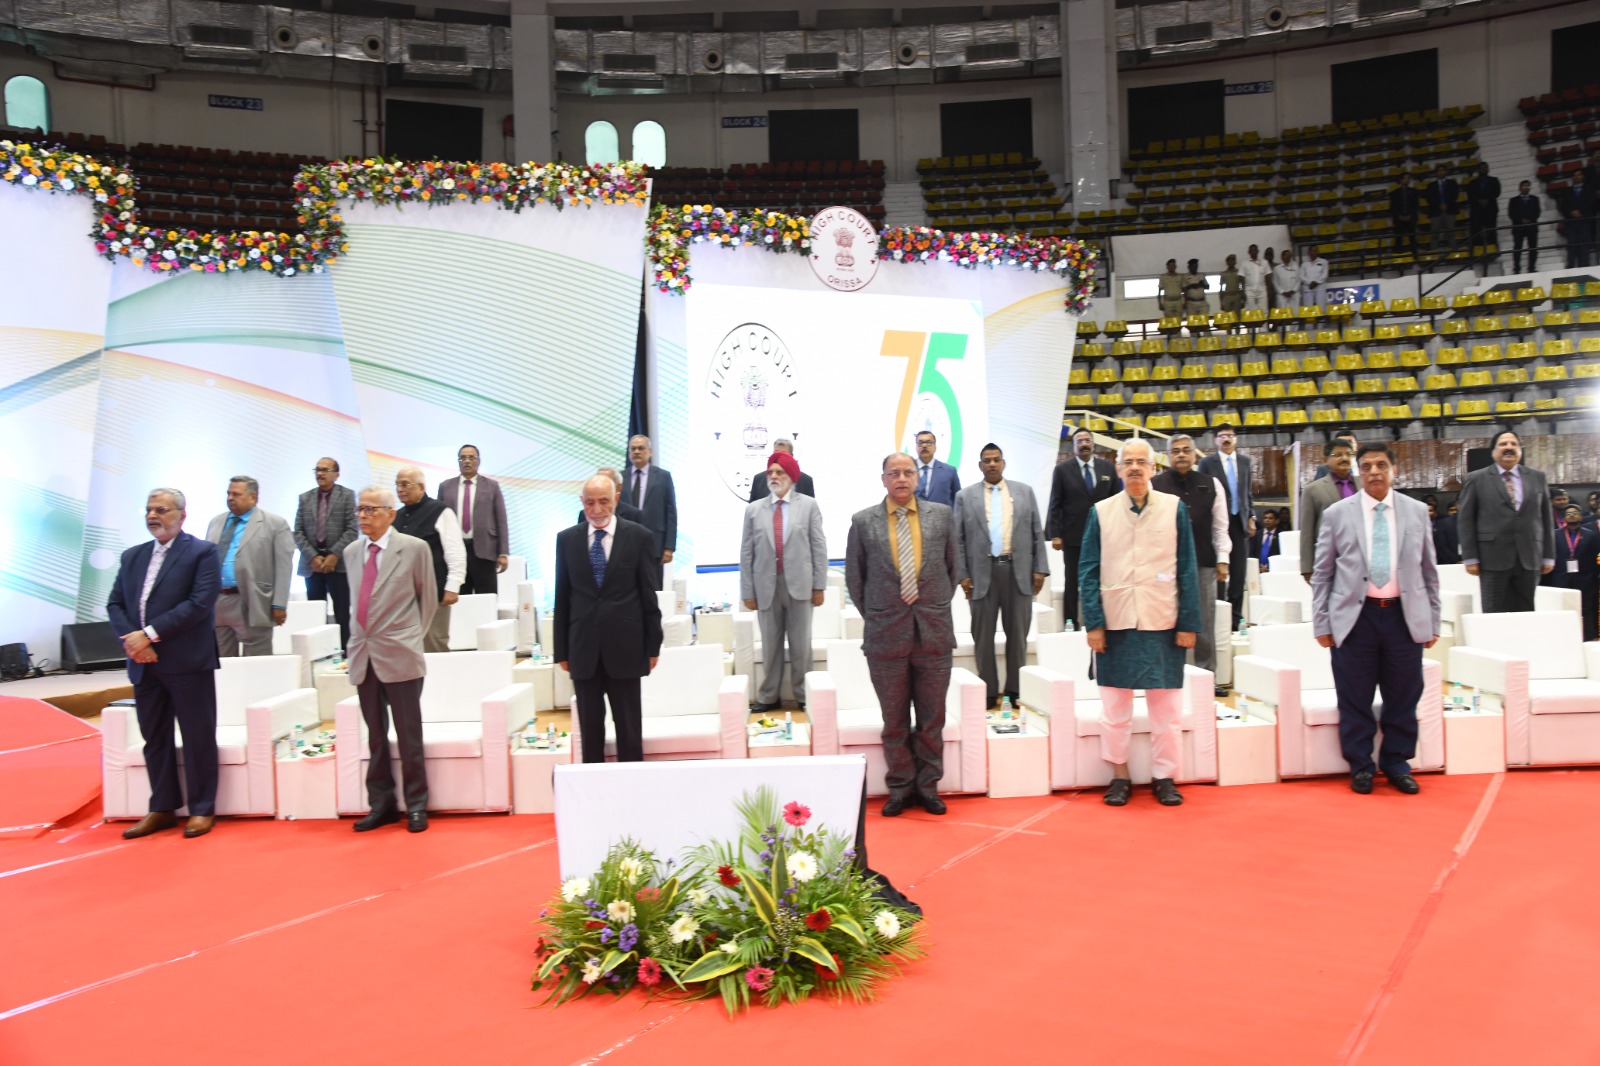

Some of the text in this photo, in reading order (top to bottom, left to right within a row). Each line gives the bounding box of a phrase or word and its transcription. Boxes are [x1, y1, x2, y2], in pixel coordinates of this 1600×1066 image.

[1225, 84, 1256, 94] BLOCK
[210, 96, 262, 110] BLOCK 23
[723, 117, 768, 127] BLOCK 24
[811, 210, 876, 245] HIGH COURT
[827, 274, 863, 288] ORISSA
[710, 337, 743, 399] HIGH
[879, 329, 969, 472] 75
